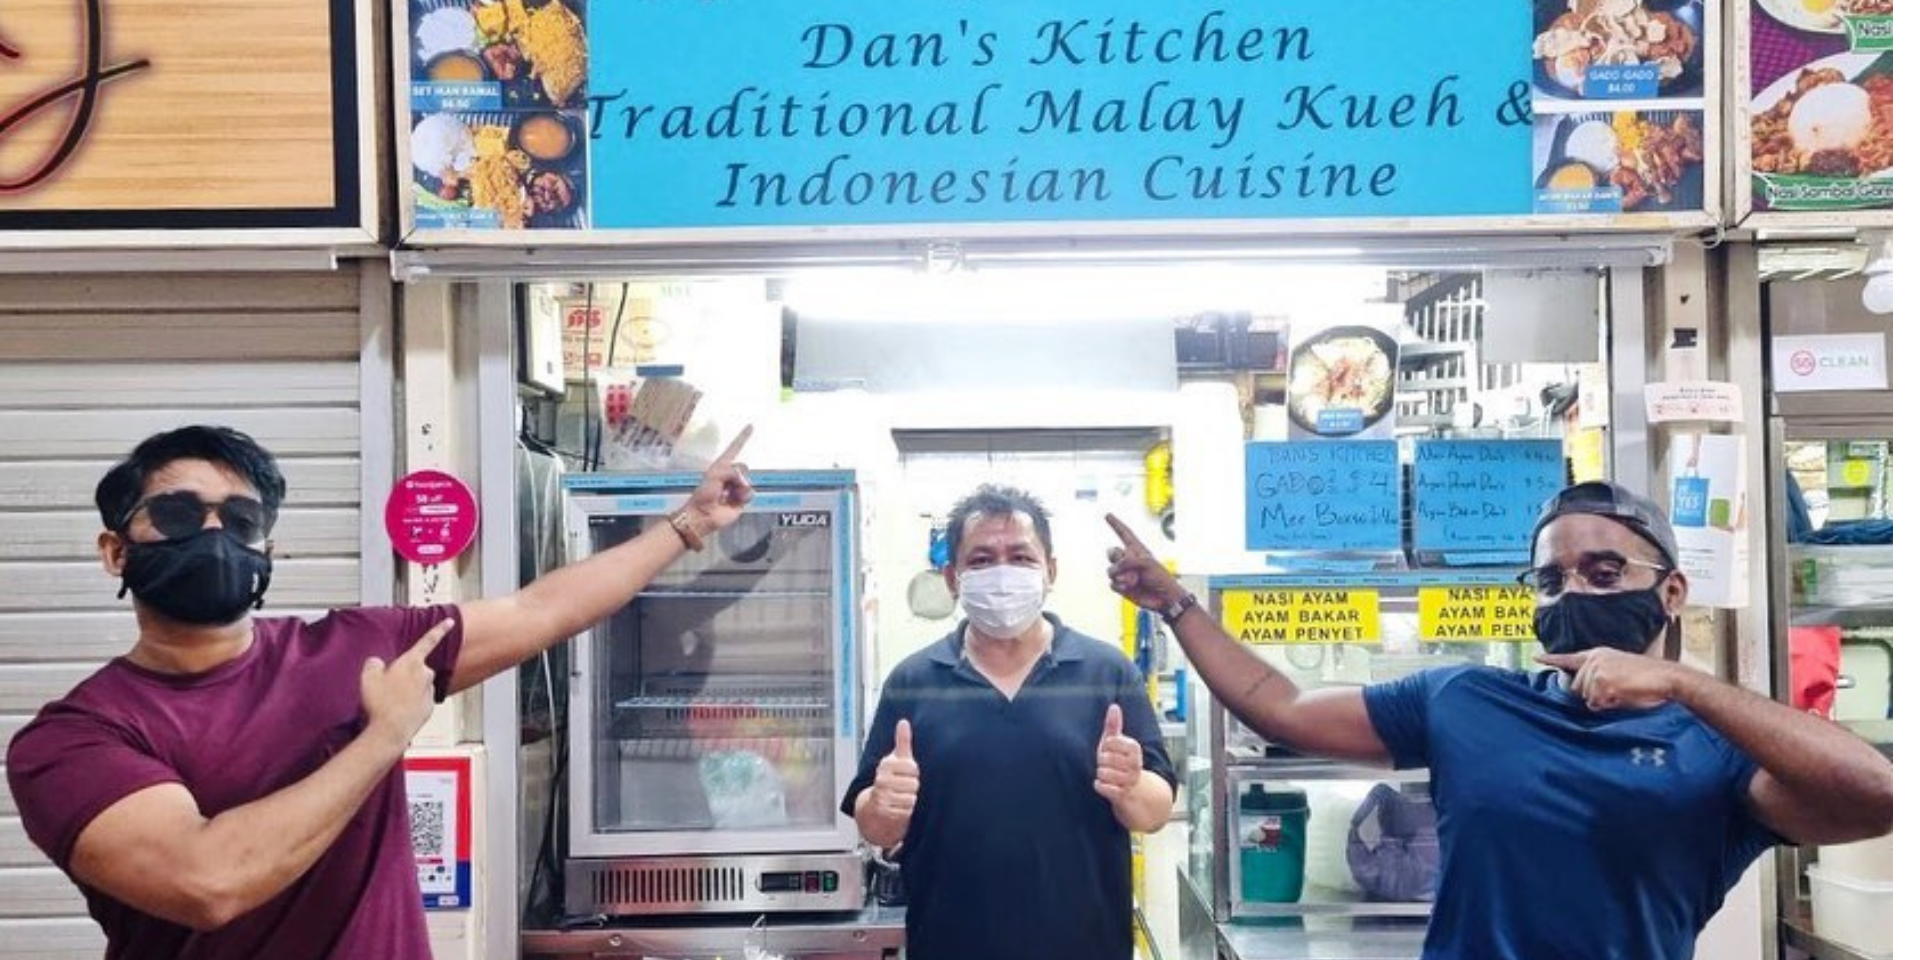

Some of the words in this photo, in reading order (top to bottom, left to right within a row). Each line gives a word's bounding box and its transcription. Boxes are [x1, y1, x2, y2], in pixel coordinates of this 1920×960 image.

[800, 18, 998, 68] Dan's
[1029, 10, 1314, 65] Kitchen
[590, 83, 1002, 140] Traditional
[1018, 80, 1245, 149] Malay
[1276, 74, 1465, 131] Kueh
[1495, 79, 1534, 127] &
[715, 154, 1107, 208] Indonesian
[1144, 152, 1397, 202] Cuisine
[1820, 354, 1870, 368] CLEAN
[781, 513, 827, 526] YUDA
[1254, 592, 1294, 605] NASI
[1302, 591, 1348, 604] AYAM
[1449, 587, 1489, 600] NASI
[1497, 586, 1530, 600] AYA
[1243, 611, 1289, 623] AYAM
[1299, 610, 1360, 623] BAKAR
[1439, 606, 1486, 619] AYAM
[1241, 628, 1286, 641] AYAM
[1296, 627, 1363, 640] PENYET
[1436, 624, 1482, 637] AYAM
